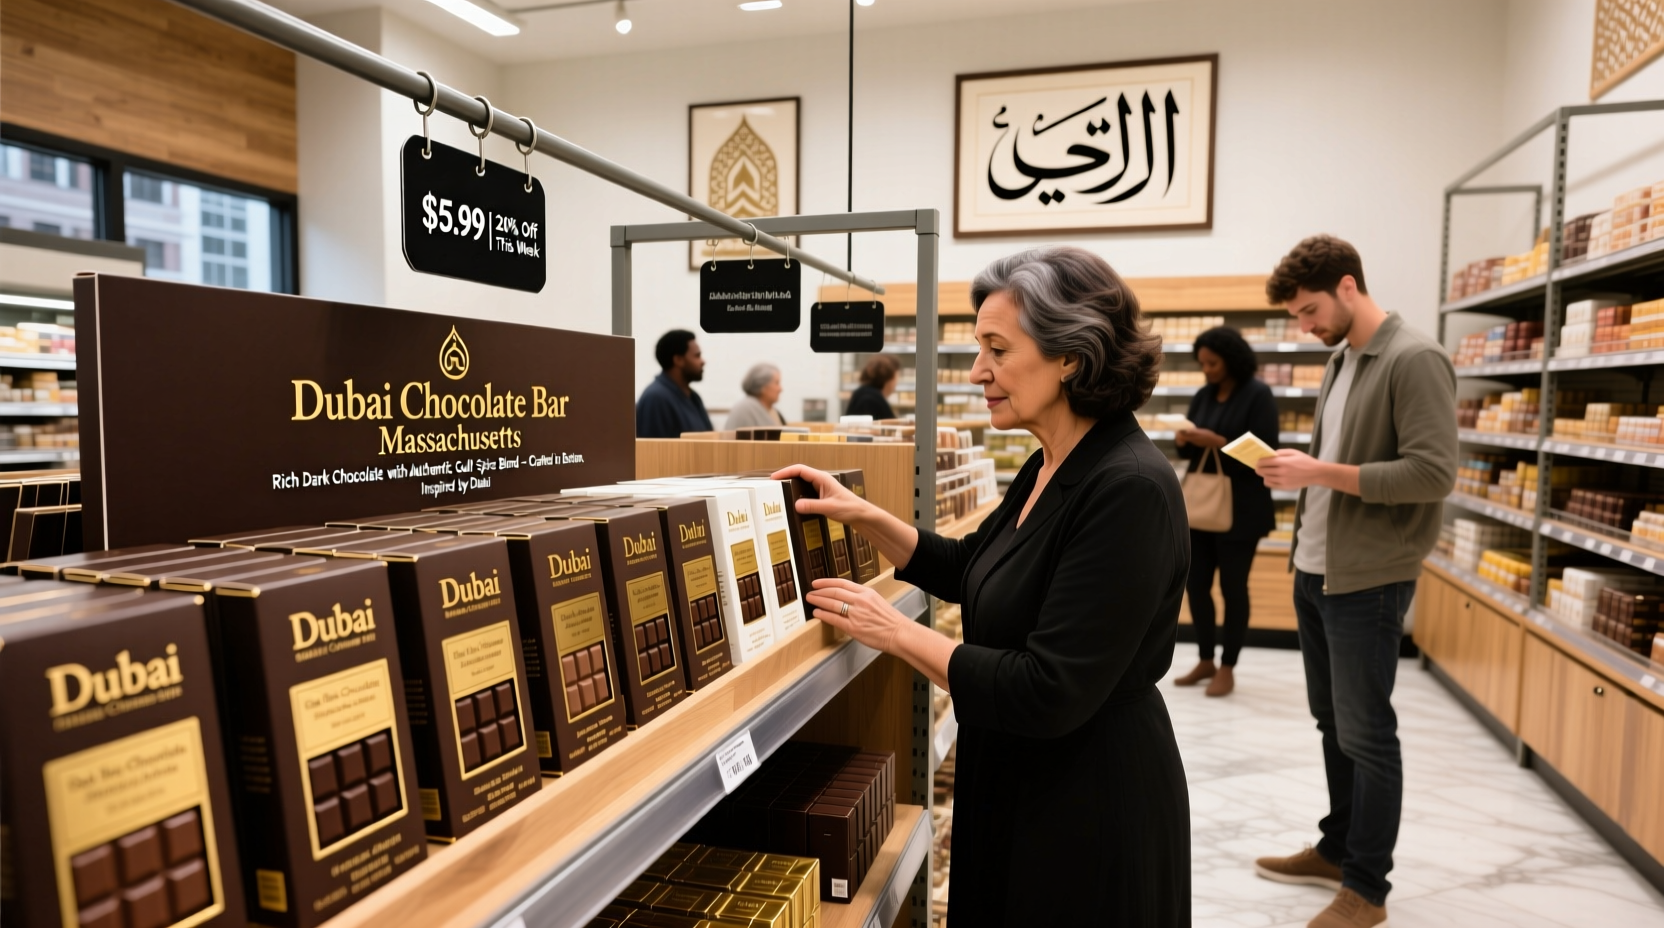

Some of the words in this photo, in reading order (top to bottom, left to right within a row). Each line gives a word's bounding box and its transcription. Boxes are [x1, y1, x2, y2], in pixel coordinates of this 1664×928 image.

[422, 190, 486, 241] $5.99
[521, 221, 539, 240] Off
[495, 236, 515, 253] This
[291, 379, 394, 421] Dubai
[400, 380, 526, 420] Chocolate
[531, 385, 570, 418] Bar
[378, 423, 522, 456] Massachusetts
[272, 471, 300, 490] Rich
[302, 468, 331, 488] Dark
[332, 465, 384, 485] Chocolate
[548, 548, 592, 579] Dubai
[438, 569, 502, 609] Dubai
[289, 598, 377, 651] Dubai
[45, 643, 184, 719] Dubai
